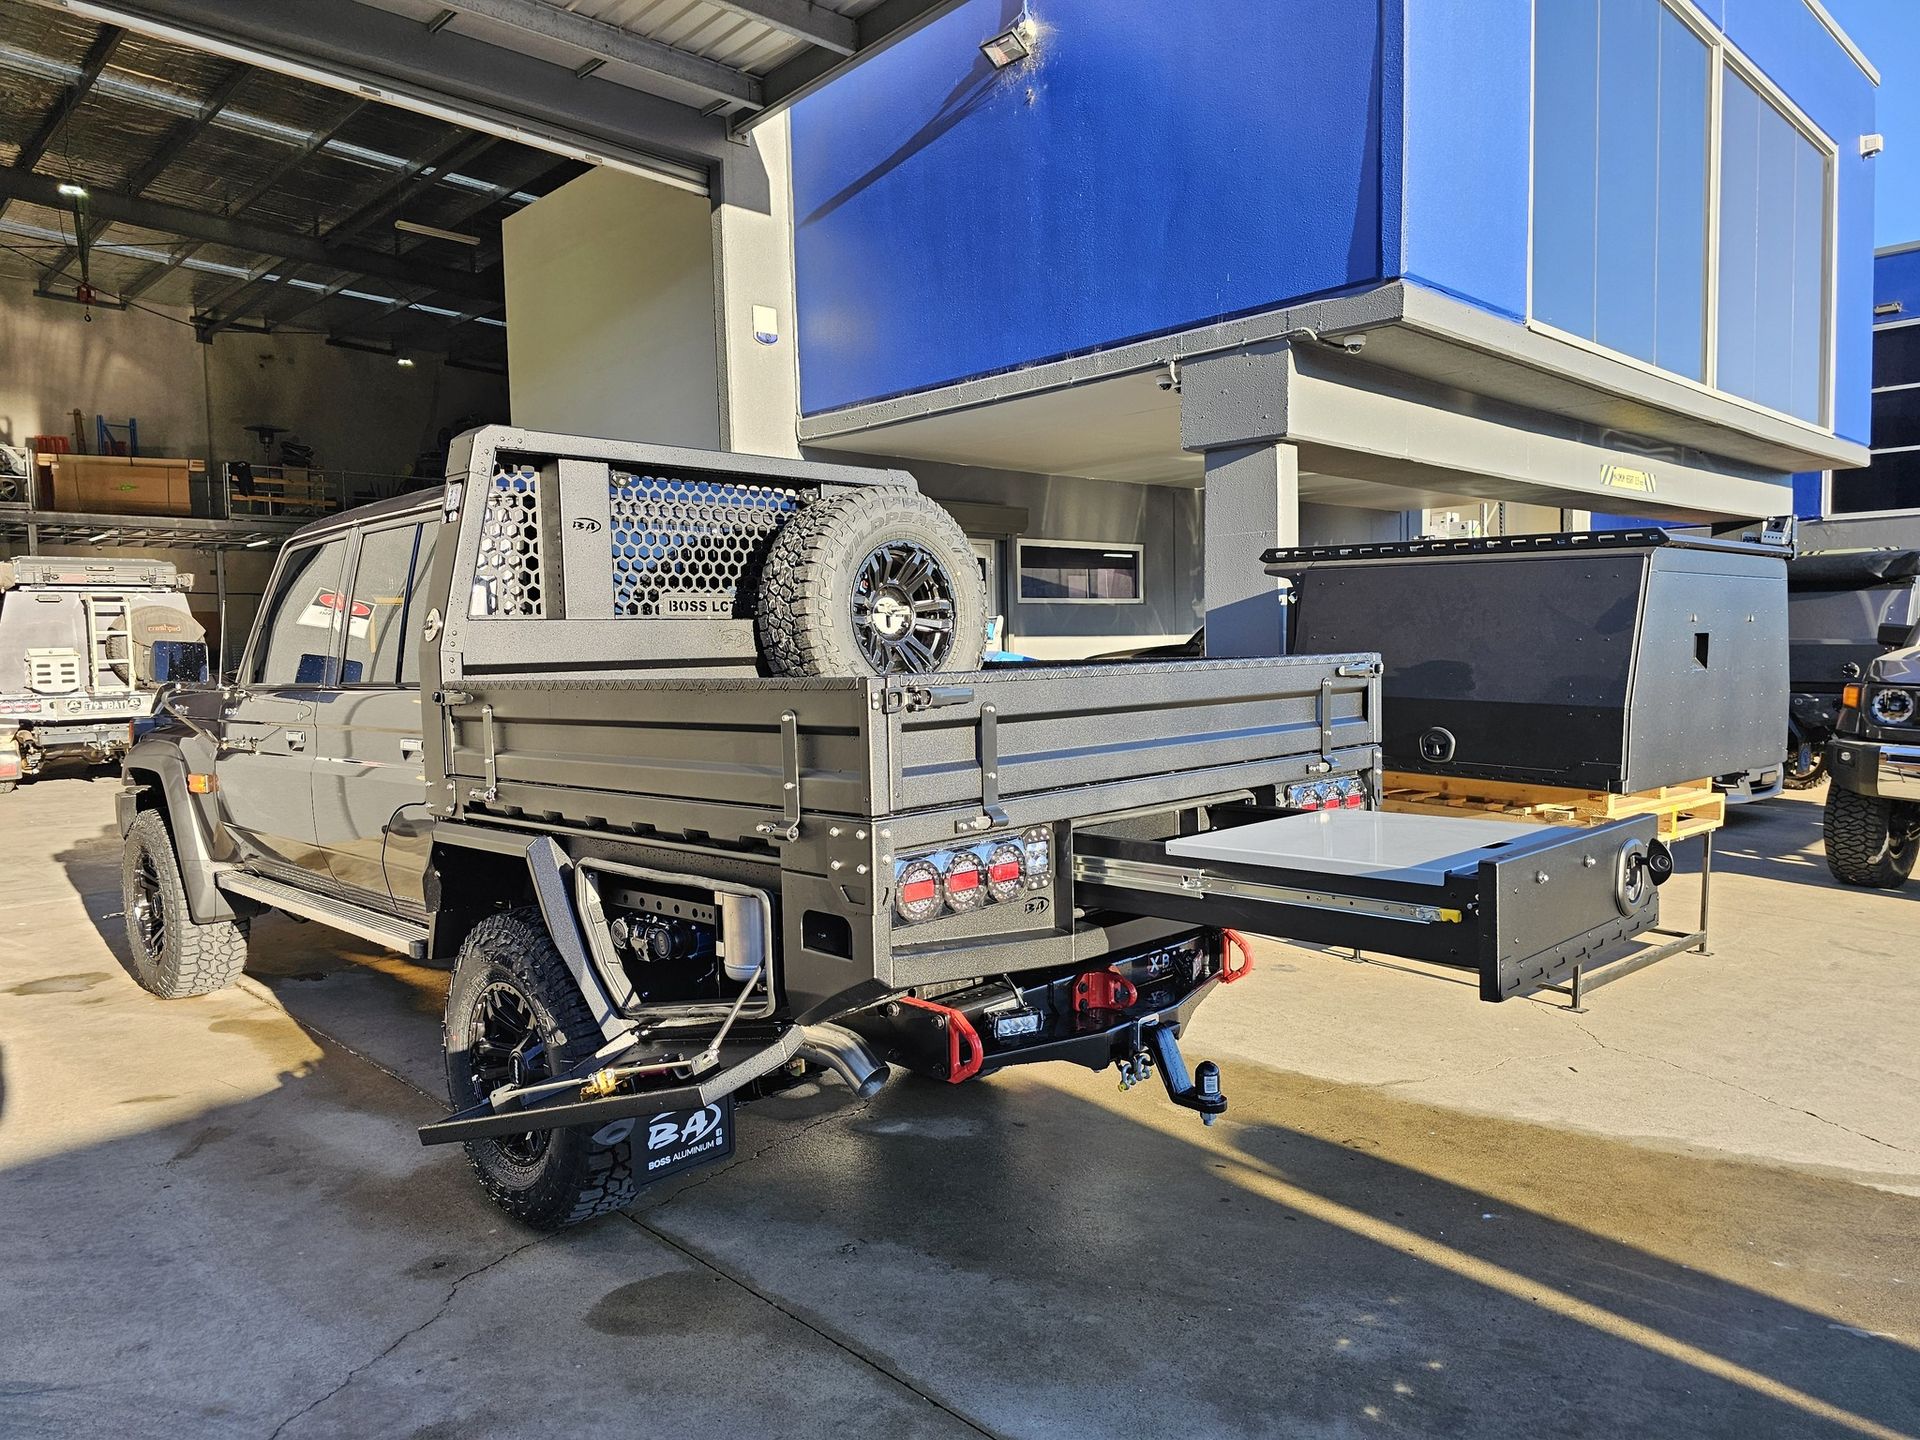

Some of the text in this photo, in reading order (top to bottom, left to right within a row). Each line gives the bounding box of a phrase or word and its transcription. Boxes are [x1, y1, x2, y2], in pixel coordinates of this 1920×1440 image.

[669, 600, 734, 612] BOSS LC
[648, 1104, 721, 1150] BA
[648, 1140, 714, 1170] BOSS ALUMINIUM
